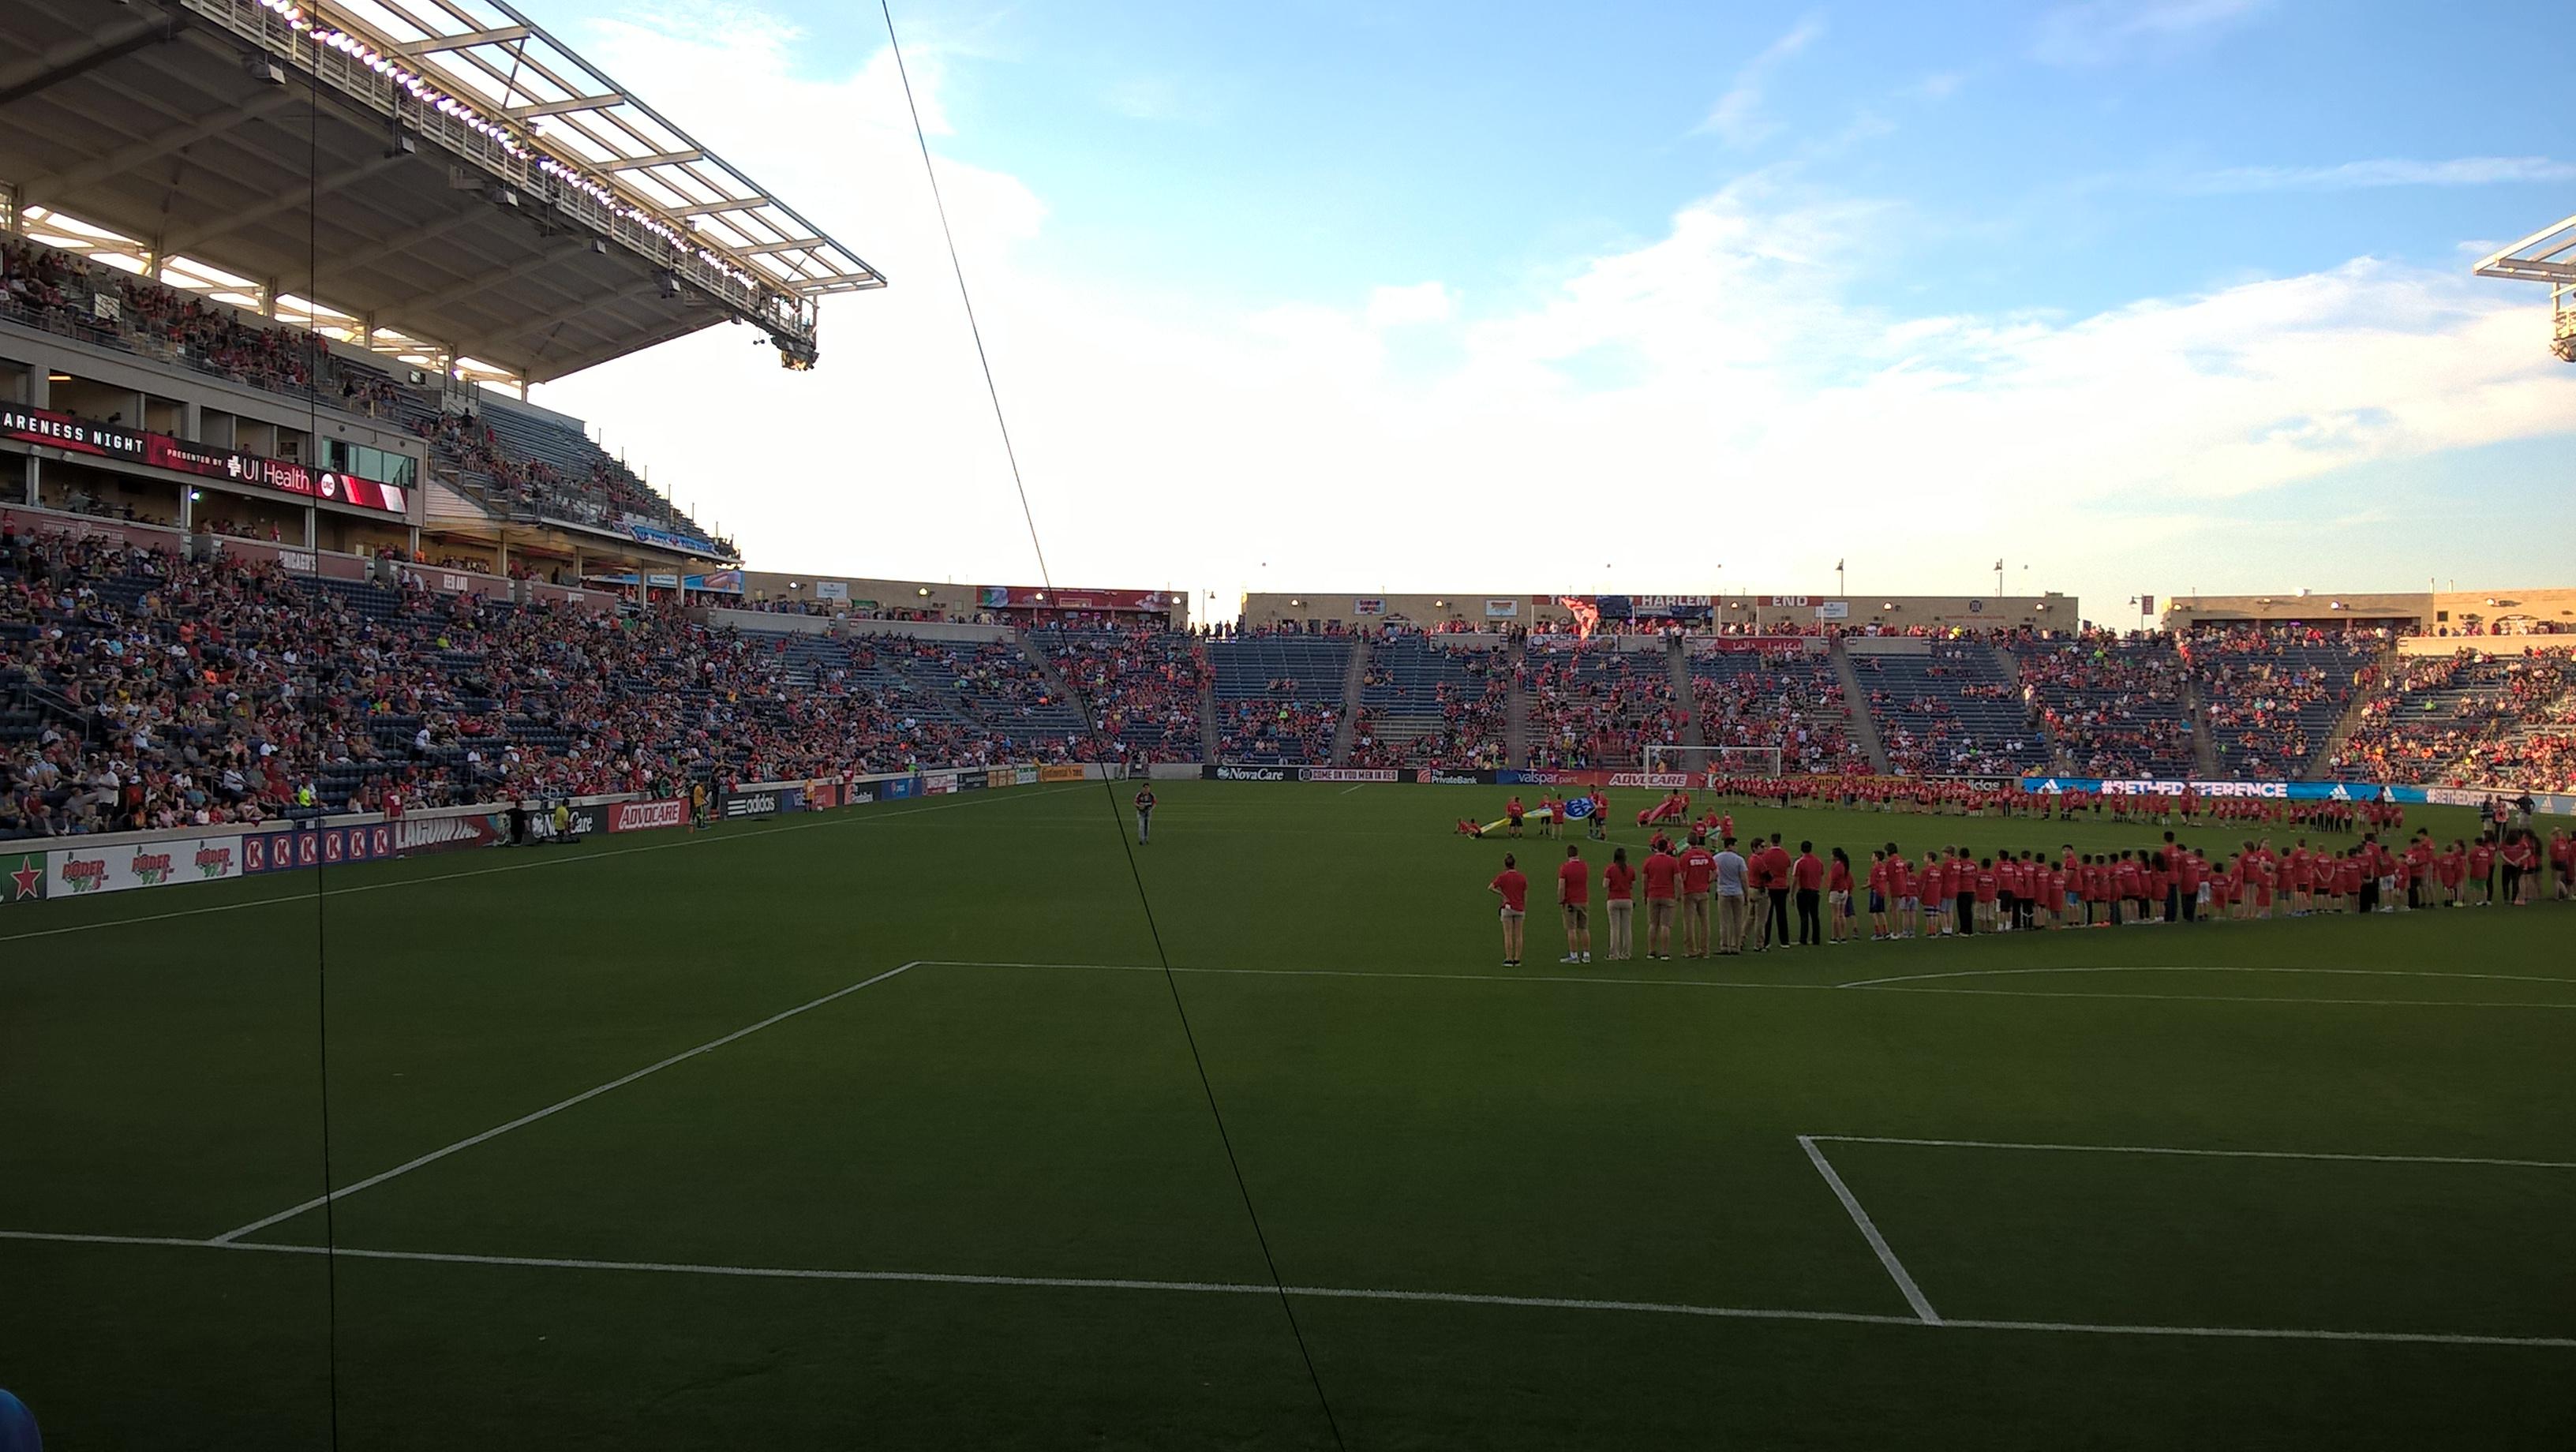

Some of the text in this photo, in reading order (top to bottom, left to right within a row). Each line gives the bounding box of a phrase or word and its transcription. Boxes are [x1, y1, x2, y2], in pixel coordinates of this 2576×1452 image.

[3, 412, 144, 453] ARENESS NIGHT
[167, 448, 223, 466] PRESENTED BY
[242, 458, 310, 492] UI Health
[1642, 596, 1712, 607] HARLEM
[1772, 596, 1809, 607] END
[1230, 767, 1285, 780] NovaCare
[1312, 770, 1332, 780] COME
[1344, 770, 1357, 780] YOU
[1358, 770, 1373, 780] MEN
[1383, 770, 1396, 780] RED
[1432, 776, 1477, 784] PrivateBank
[1518, 771, 1559, 786] valspar
[746, 793, 777, 814] adidas
[619, 801, 681, 830] ADVOCARE
[132, 854, 170, 873] PODER
[196, 848, 230, 866] PODER
[62, 860, 105, 880] PODER
